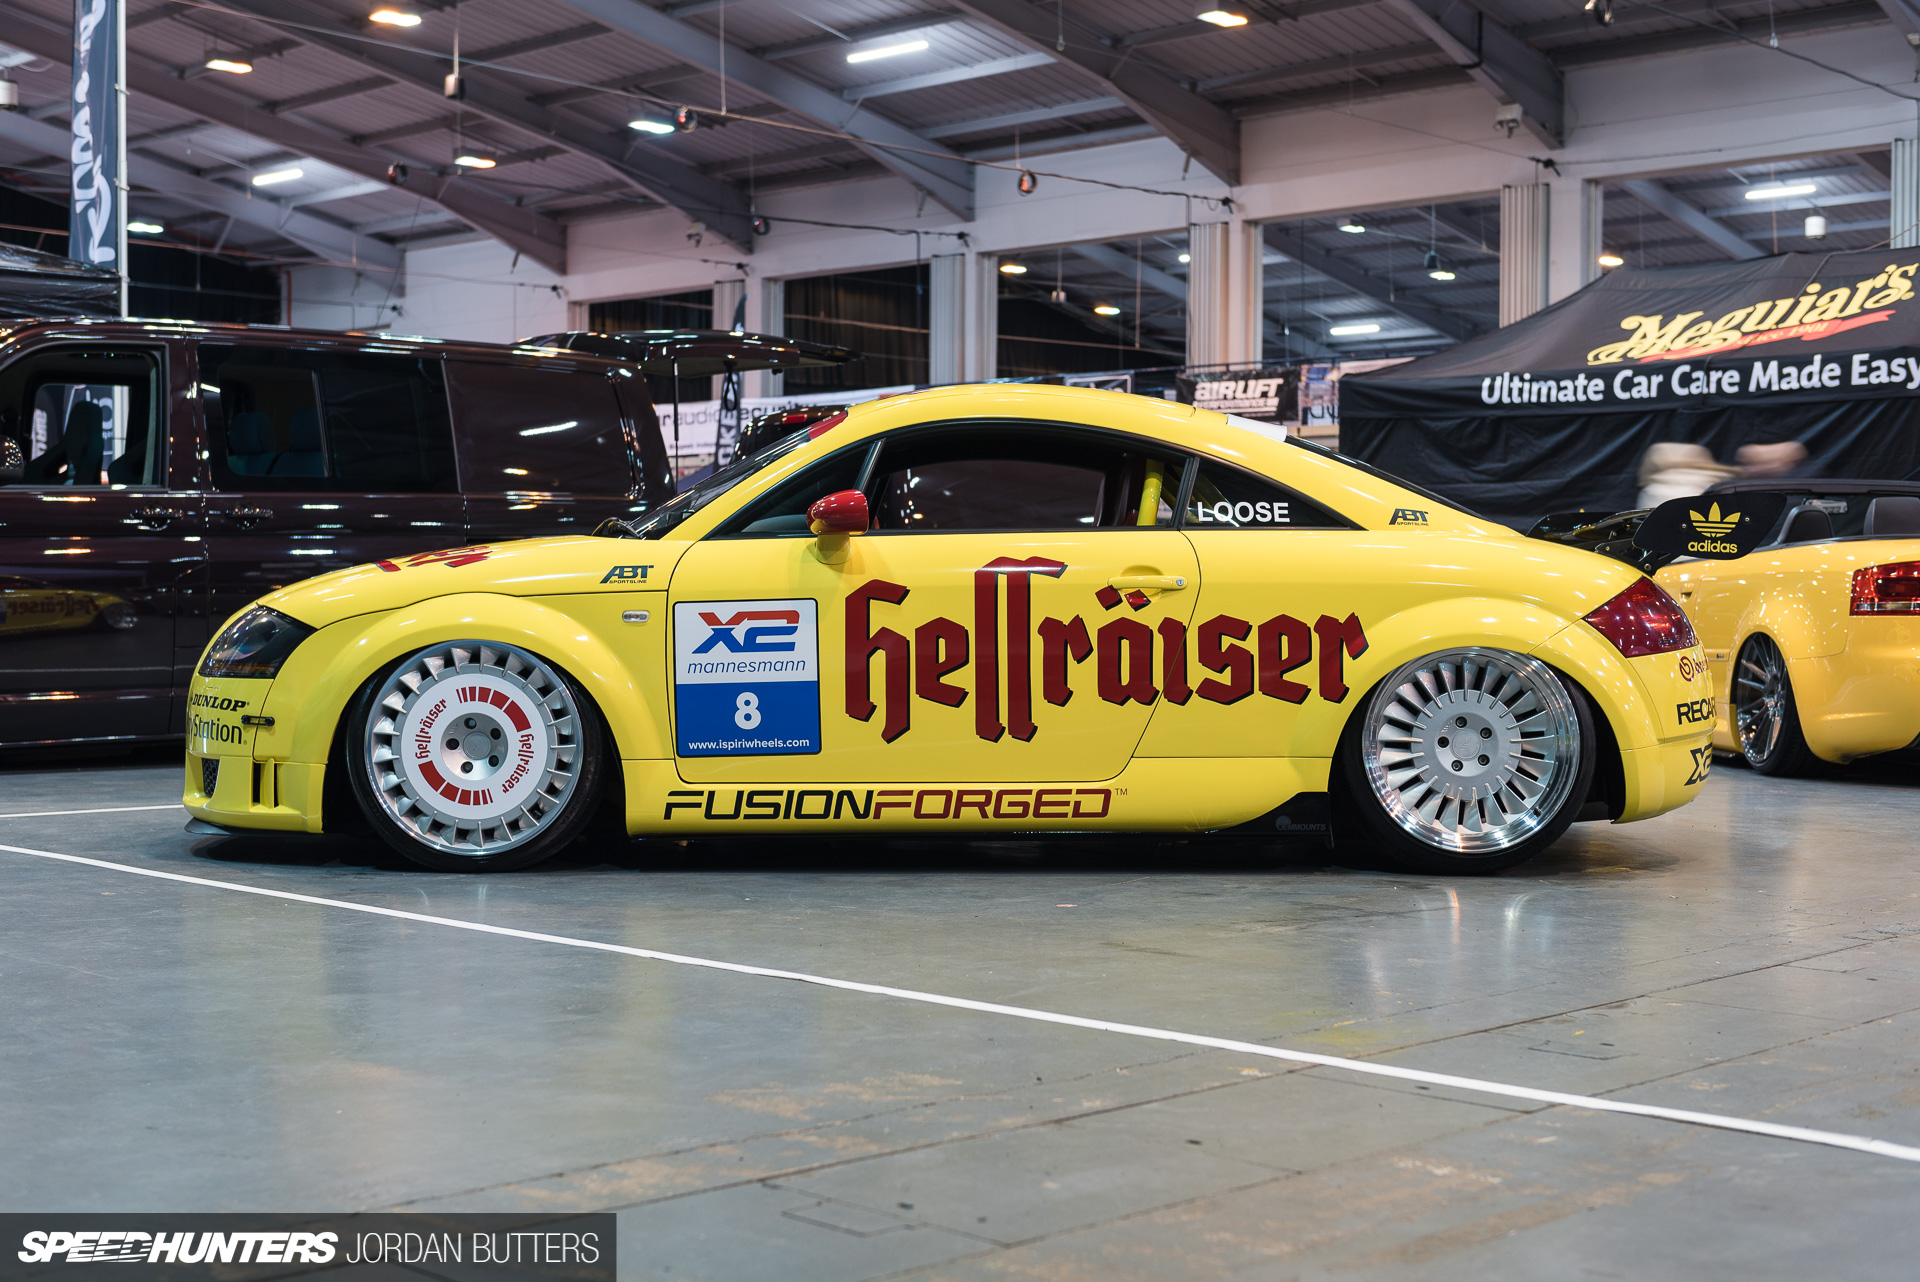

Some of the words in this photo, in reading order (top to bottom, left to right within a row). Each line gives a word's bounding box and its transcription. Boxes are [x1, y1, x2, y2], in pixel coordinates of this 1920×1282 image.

[1587, 263, 1919, 365] Meguiar's
[1481, 371, 1605, 404] Ultimate
[1612, 368, 1664, 400] Car
[1670, 364, 1741, 396] Care
[1748, 353, 1842, 393] Made
[1850, 352, 1920, 391] Easy
[1197, 501, 1290, 523] LOOSE
[1388, 508, 1429, 525] ABT
[1688, 540, 1738, 554] adidas
[599, 565, 655, 584] ABT
[691, 609, 800, 655] X2
[687, 659, 806, 674] mannesmann
[734, 691, 762, 730] 8
[1676, 696, 1718, 725] RECAR
[688, 738, 810, 750] www.ispiriwheels.com
